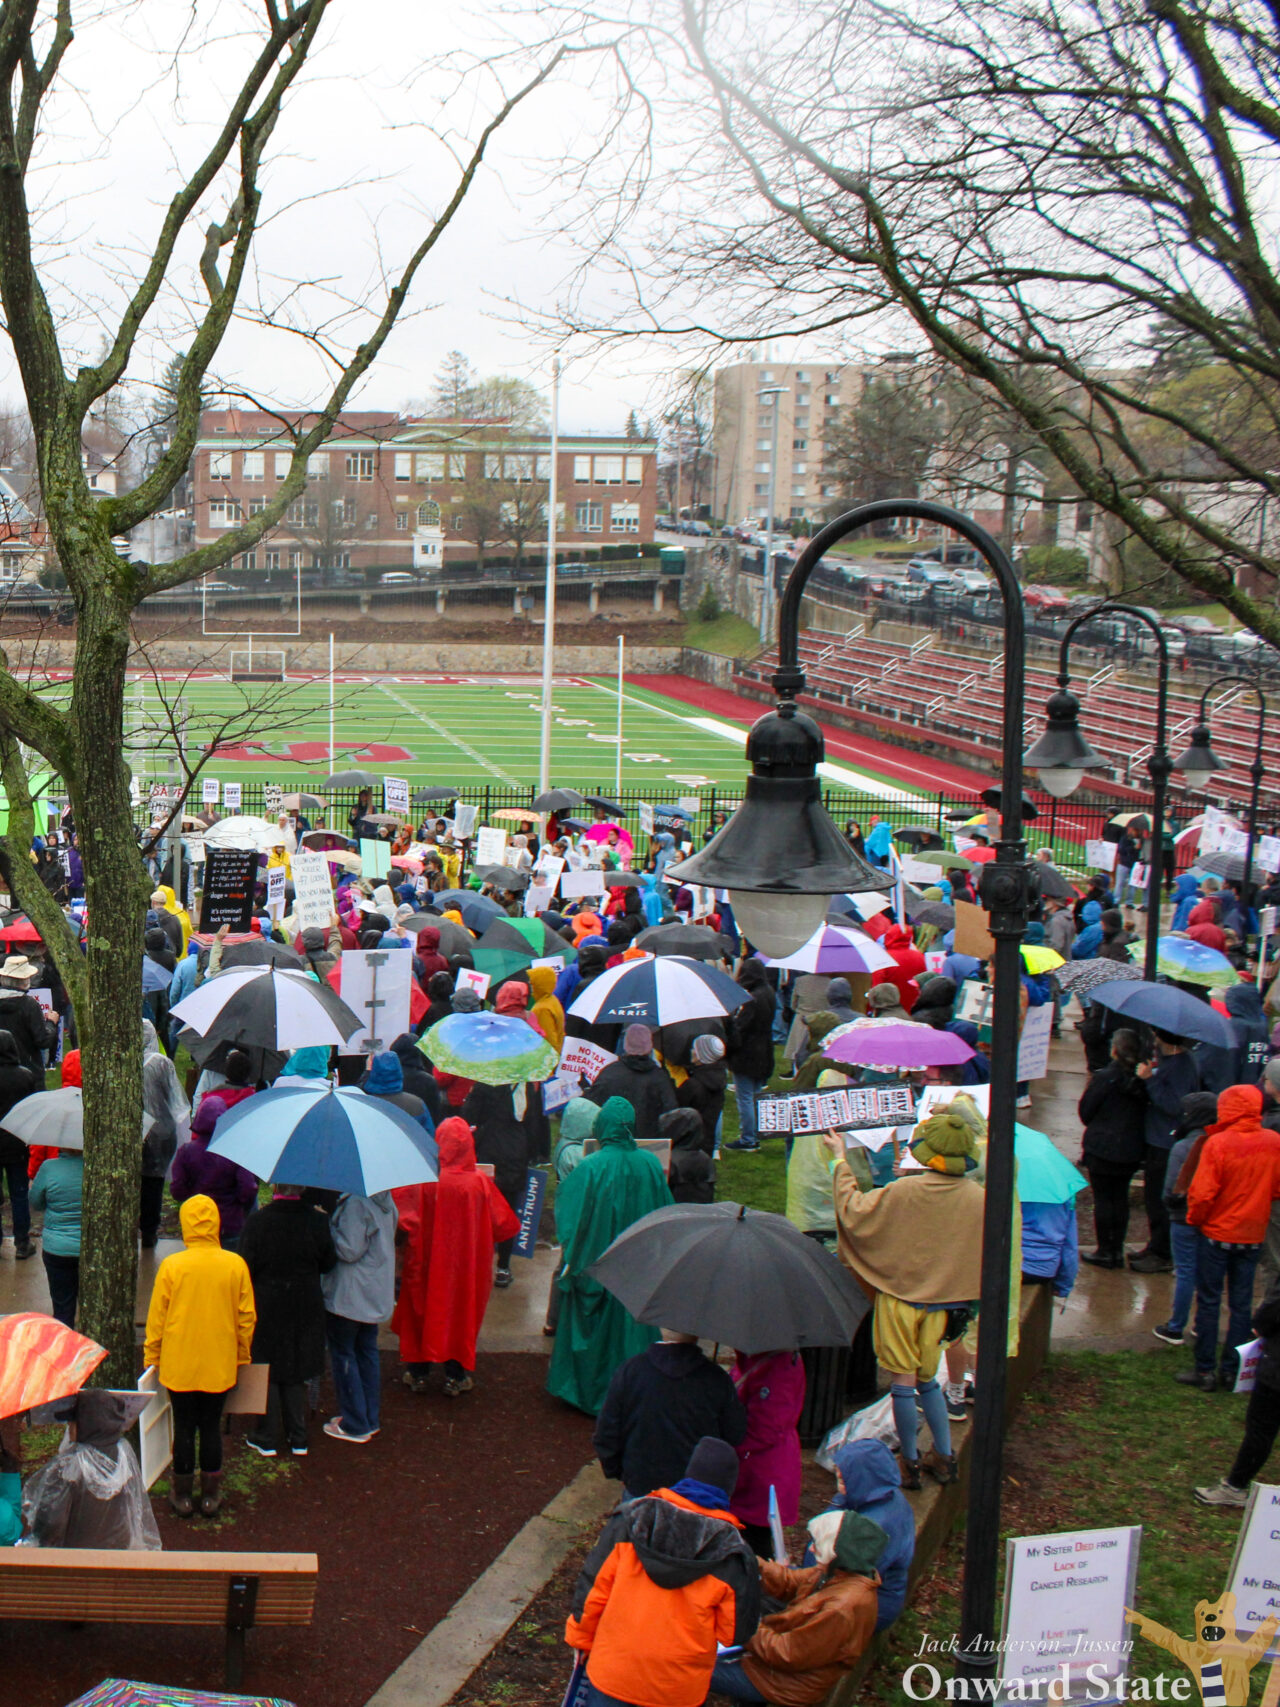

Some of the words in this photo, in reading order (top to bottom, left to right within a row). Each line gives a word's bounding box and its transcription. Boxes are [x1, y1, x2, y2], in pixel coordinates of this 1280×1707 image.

[567, 1054, 594, 1069] BREAKS
[578, 1046, 591, 1056] NO
[592, 1052, 606, 1064] TAX
[896, 1090, 907, 1112] AIR
[791, 1100, 799, 1130] HANDS
[798, 1100, 809, 1128] OFF!
[518, 1176, 539, 1250] ANTI-TRUMP
[1043, 1545, 1072, 1556] SISTER
[1074, 1542, 1094, 1552] DIED
[1096, 1540, 1118, 1550] FROM
[1054, 1562, 1076, 1572] LACK
[1078, 1560, 1088, 1569] OF
[1030, 1581, 1064, 1592] CANCER
[1066, 1576, 1108, 1588] RESEARCH
[1243, 1577, 1259, 1588] MY
[1022, 1665, 1056, 1676] CANCER
